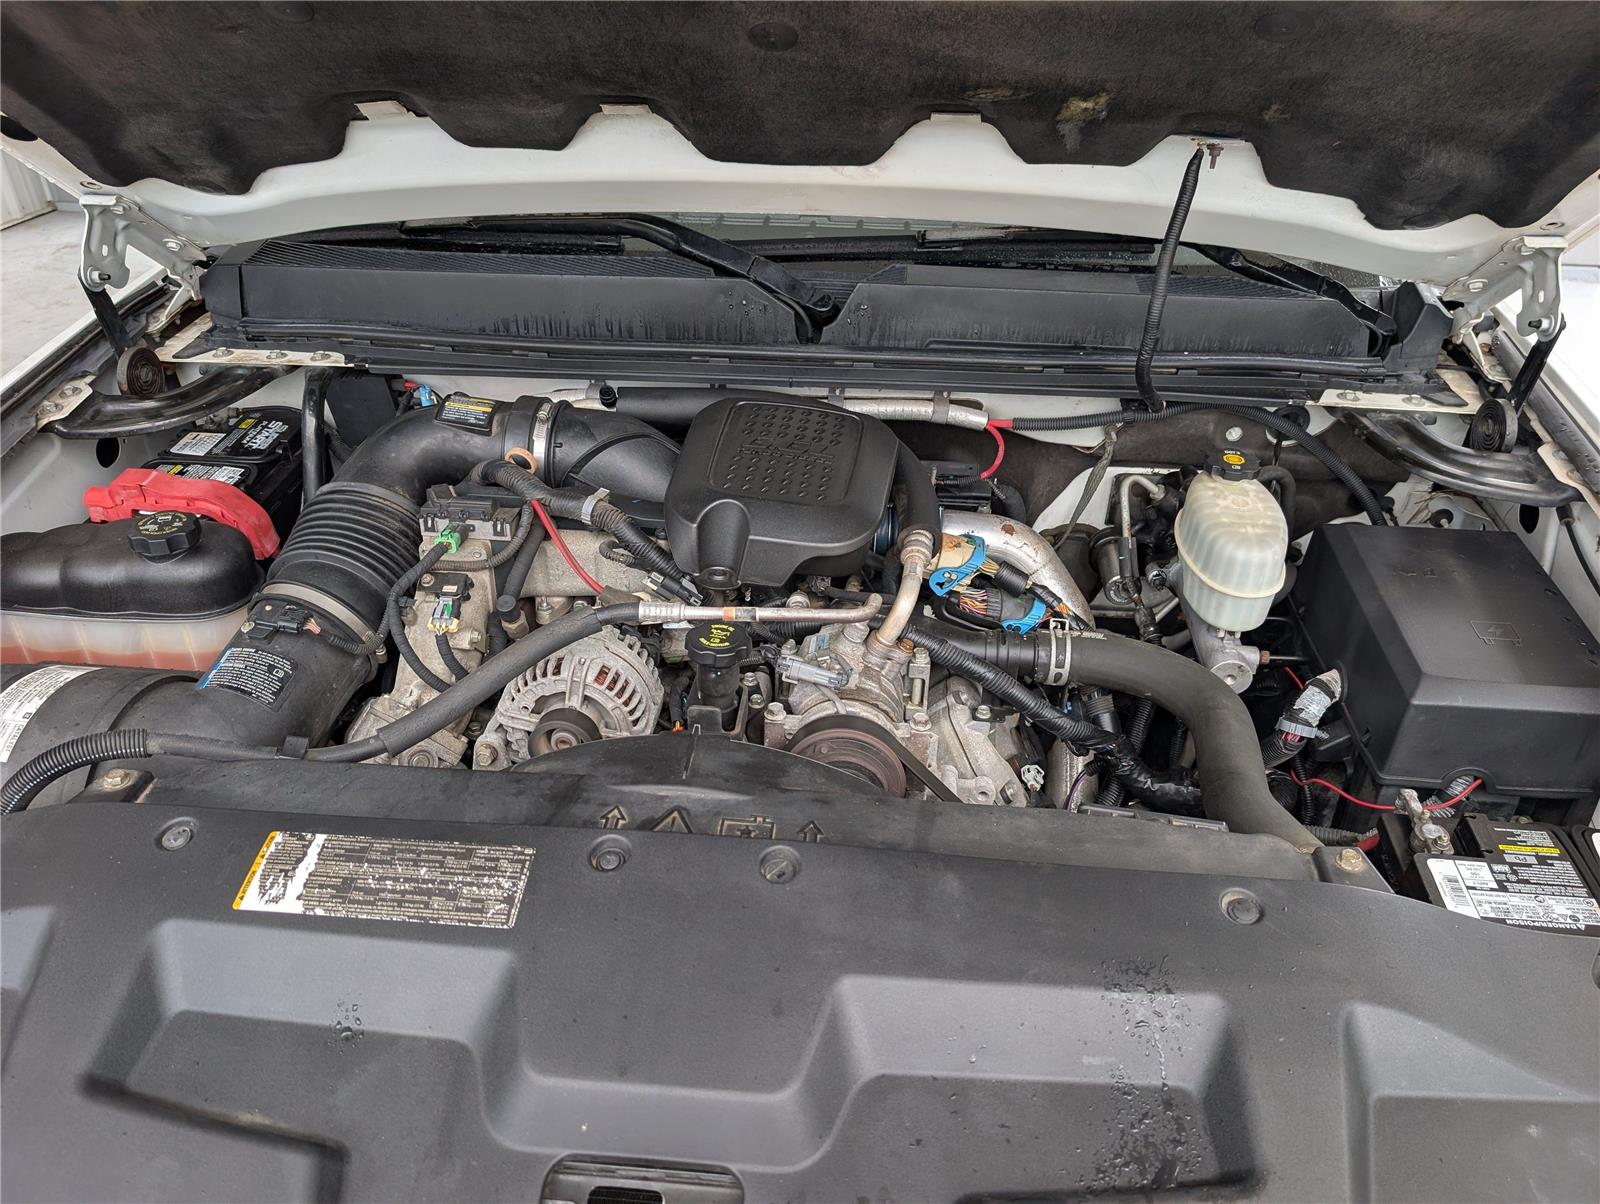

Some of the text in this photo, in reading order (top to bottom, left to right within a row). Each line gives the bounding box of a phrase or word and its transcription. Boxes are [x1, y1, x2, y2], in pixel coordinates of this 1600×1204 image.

[244, 420, 283, 449] START
[257, 424, 289, 450] SUPER
[5, 723, 25, 752] CATALYST
[1514, 855, 1528, 863] Pb
[1505, 918, 1578, 930] DANGER/POISON
